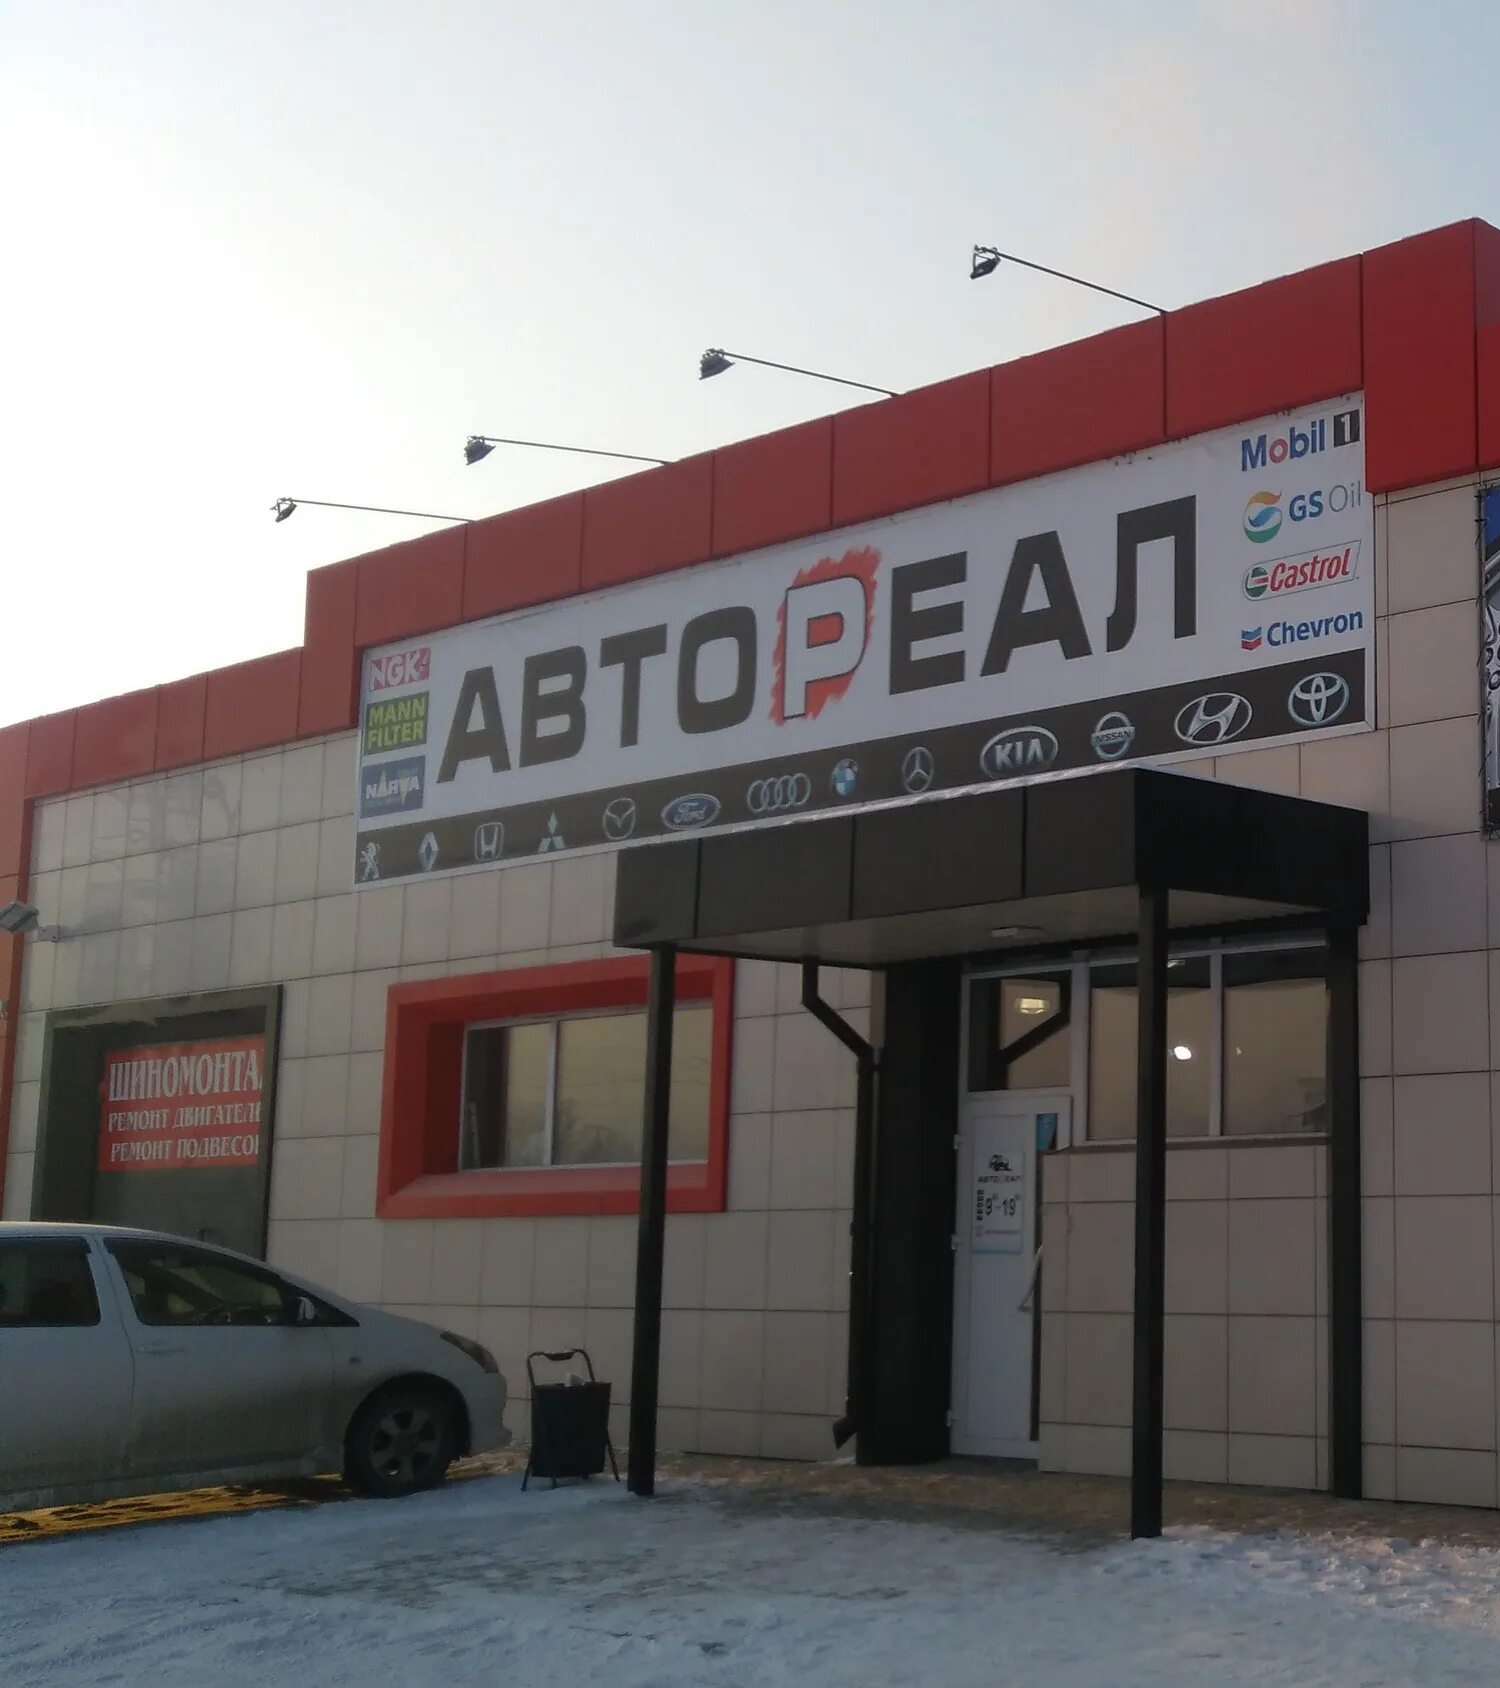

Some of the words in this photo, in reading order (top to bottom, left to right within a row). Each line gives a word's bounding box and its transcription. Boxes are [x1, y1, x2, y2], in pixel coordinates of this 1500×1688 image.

[1241, 418, 1326, 472] Mobil
[1289, 490, 1324, 522] GS
[1329, 480, 1361, 512] Oil
[1269, 547, 1352, 592] Castrol
[437, 494, 1197, 783] АВТОРЕАЛ
[1267, 610, 1363, 647] Chevron
[369, 650, 421, 691] NGK
[369, 694, 426, 727] MANN
[367, 719, 425, 749] FILTER
[995, 739, 1044, 770] KIA
[108, 1049, 263, 1102] ШИНОМОНТА
[108, 1108, 170, 1133] РЕМОНТ
[110, 1139, 173, 1163] РЕМОНТ
